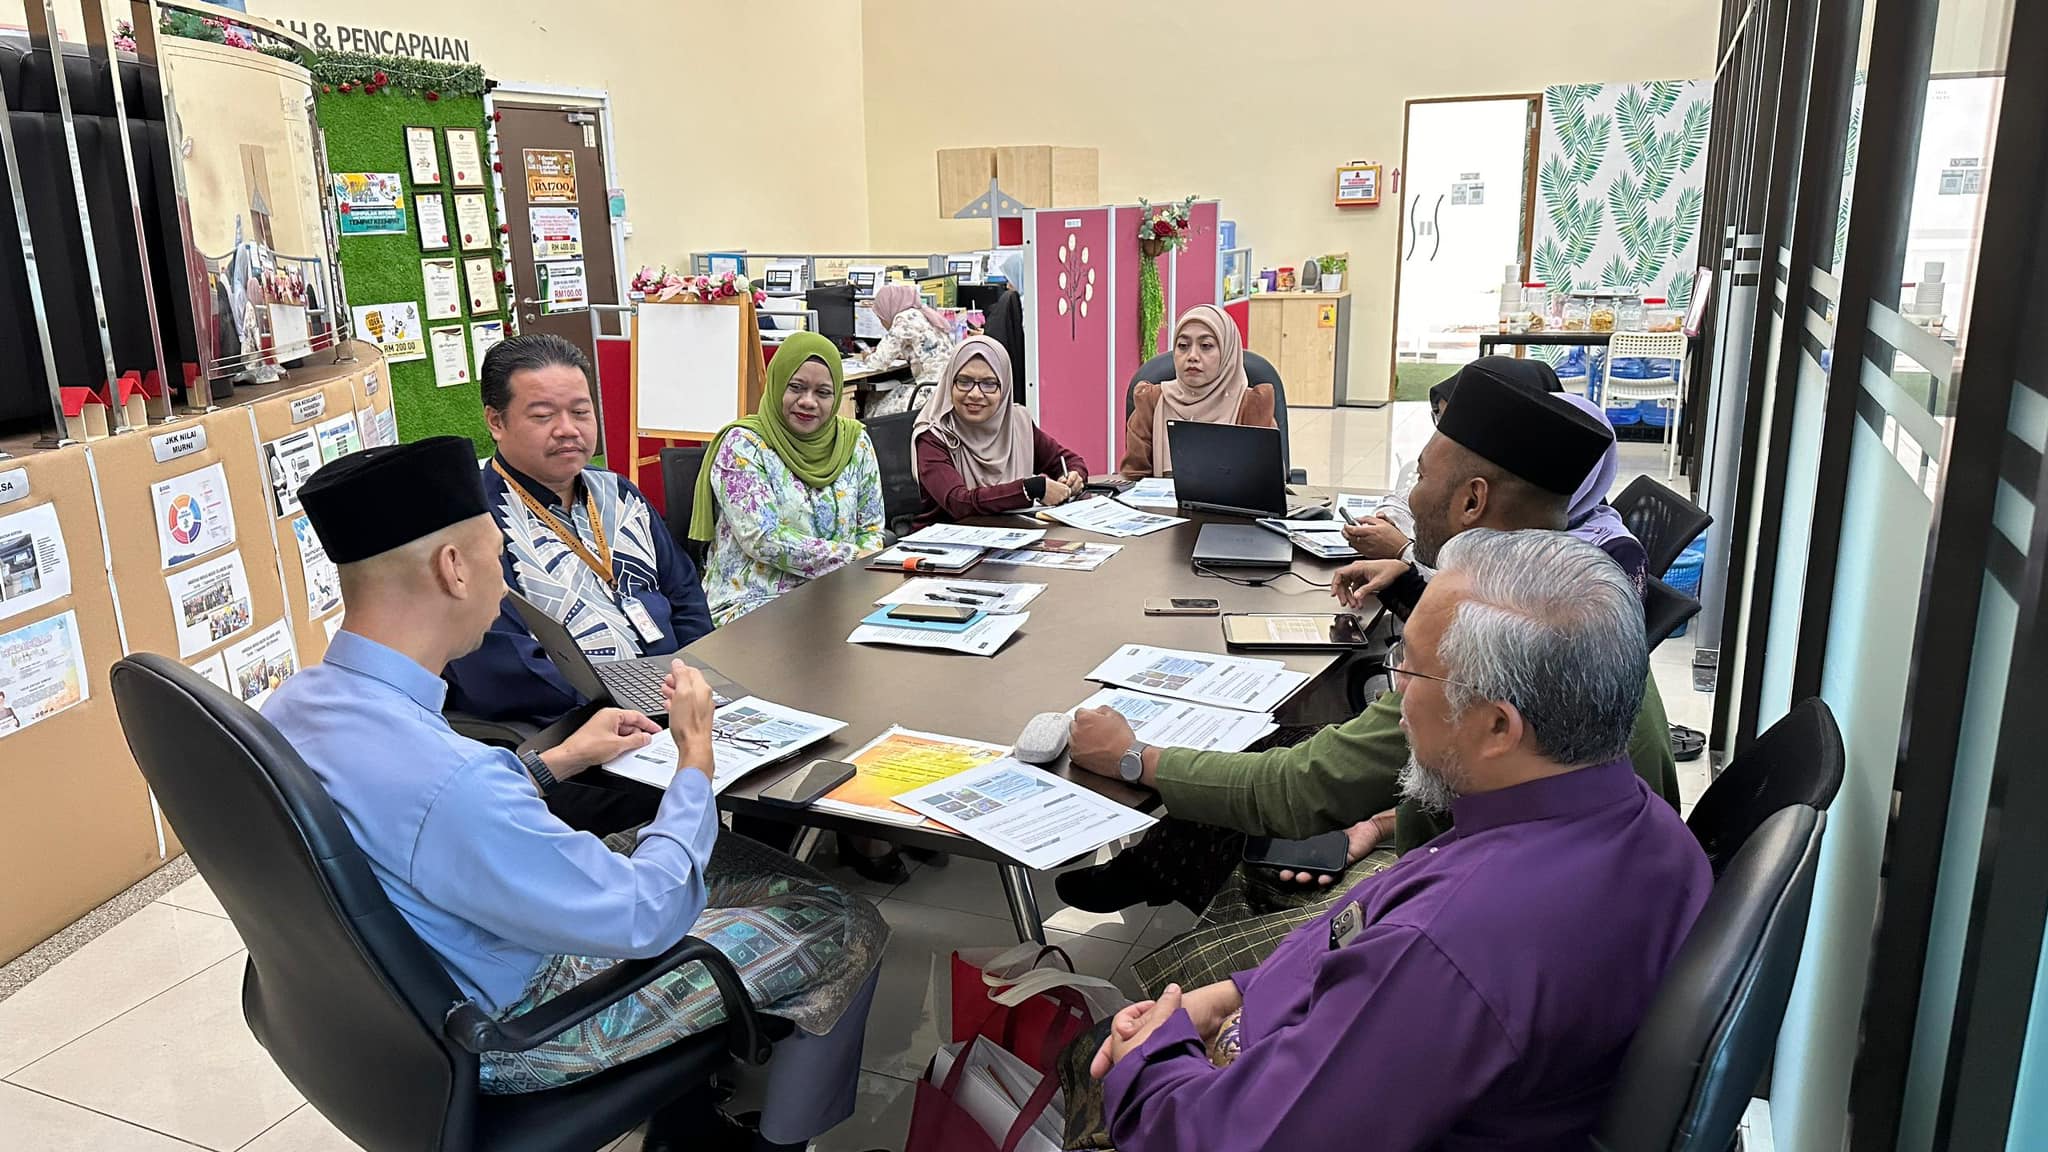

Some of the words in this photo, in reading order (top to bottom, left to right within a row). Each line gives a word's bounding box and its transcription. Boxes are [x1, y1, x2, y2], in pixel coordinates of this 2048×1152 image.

[313, 22, 334, 50] &
[336, 26, 471, 63] PENCAPAIAN
[534, 182, 570, 192] RM700
[384, 344, 394, 352] RM
[395, 342, 415, 351] 200.00
[164, 434, 179, 445] JKK
[179, 430, 197, 441] NILAI
[172, 441, 194, 454] MURNI
[0, 482, 14, 493] SA
